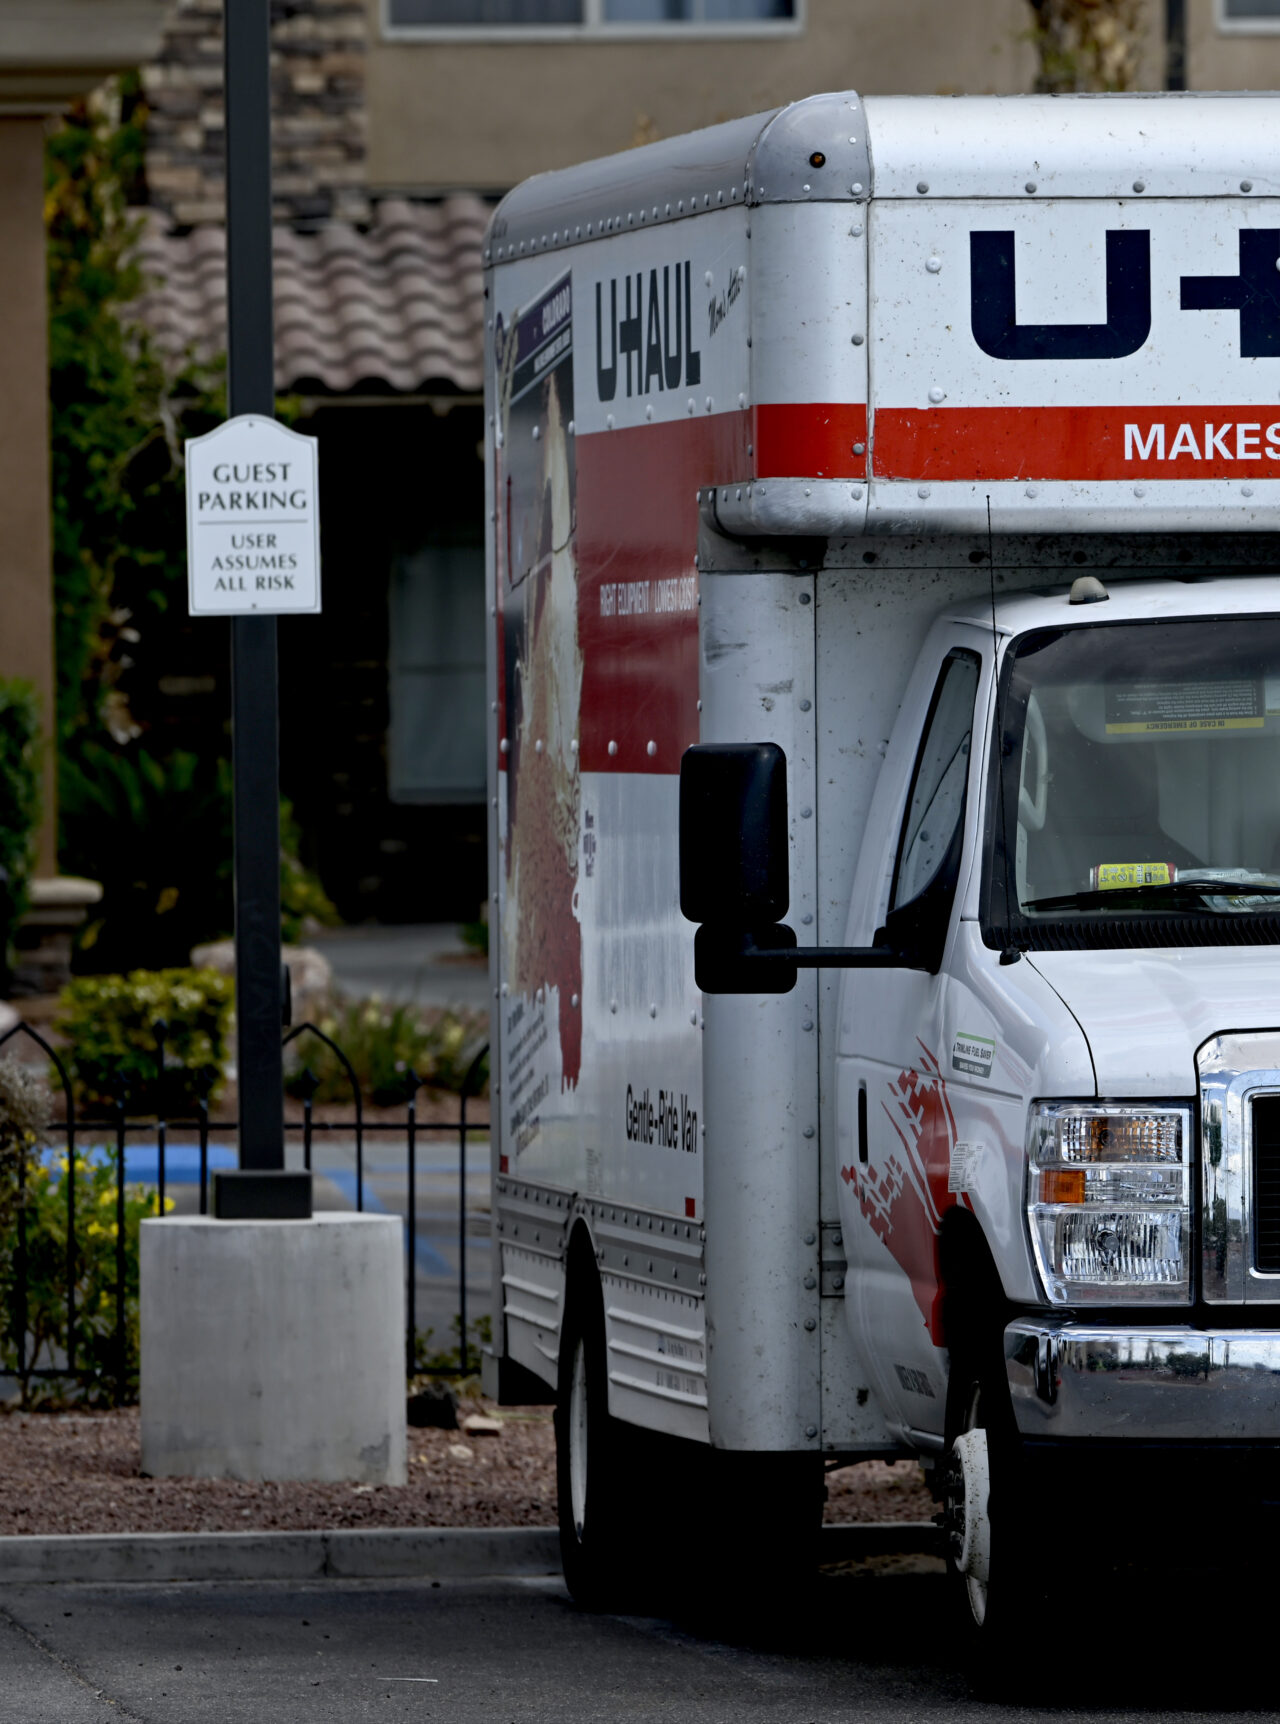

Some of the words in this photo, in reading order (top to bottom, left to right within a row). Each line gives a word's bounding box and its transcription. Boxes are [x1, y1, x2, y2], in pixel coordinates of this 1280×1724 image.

[595, 260, 701, 402] U-HAUL
[213, 463, 292, 484] GUEST
[198, 490, 307, 511] PARKING
[231, 533, 277, 549] USER
[212, 554, 298, 571] ASSUMES
[214, 576, 247, 591] ALL
[255, 575, 295, 591] RISK
[626, 1083, 678, 1150] Gentle-Ride
[681, 1093, 698, 1154] Van
